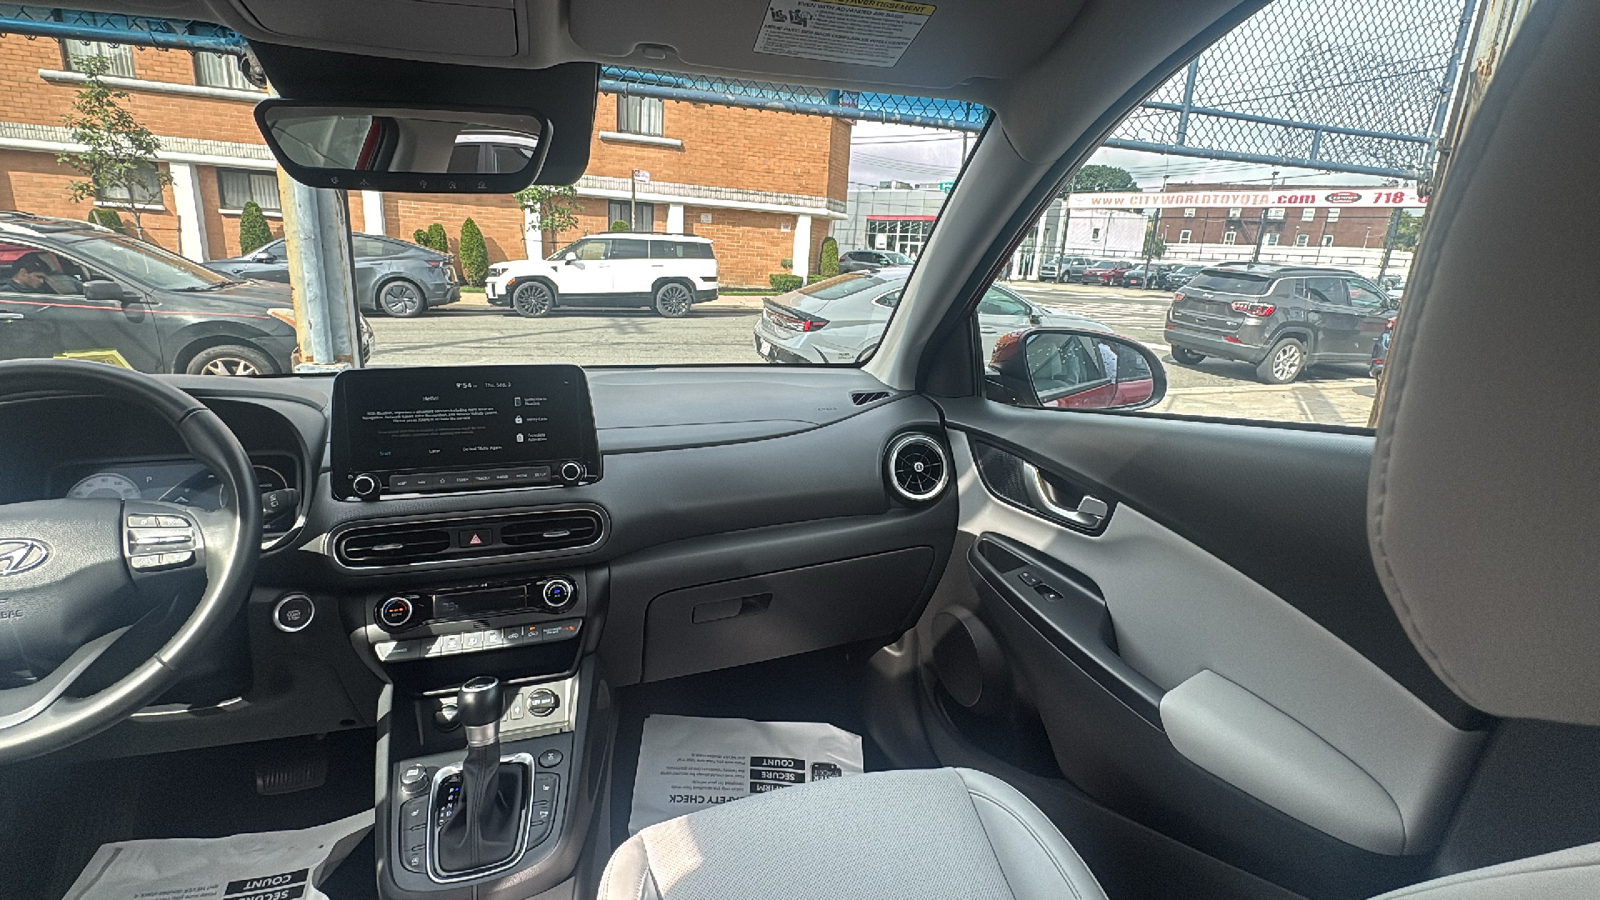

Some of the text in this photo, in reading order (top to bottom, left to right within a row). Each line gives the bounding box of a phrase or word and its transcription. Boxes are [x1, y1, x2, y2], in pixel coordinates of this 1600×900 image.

[836, 6, 872, 16] ADVANCED
[761, 758, 794, 767] COUNT
[761, 771, 796, 781] SECURE
[669, 794, 705, 804] CHECK
[243, 874, 292, 890] COUNT
